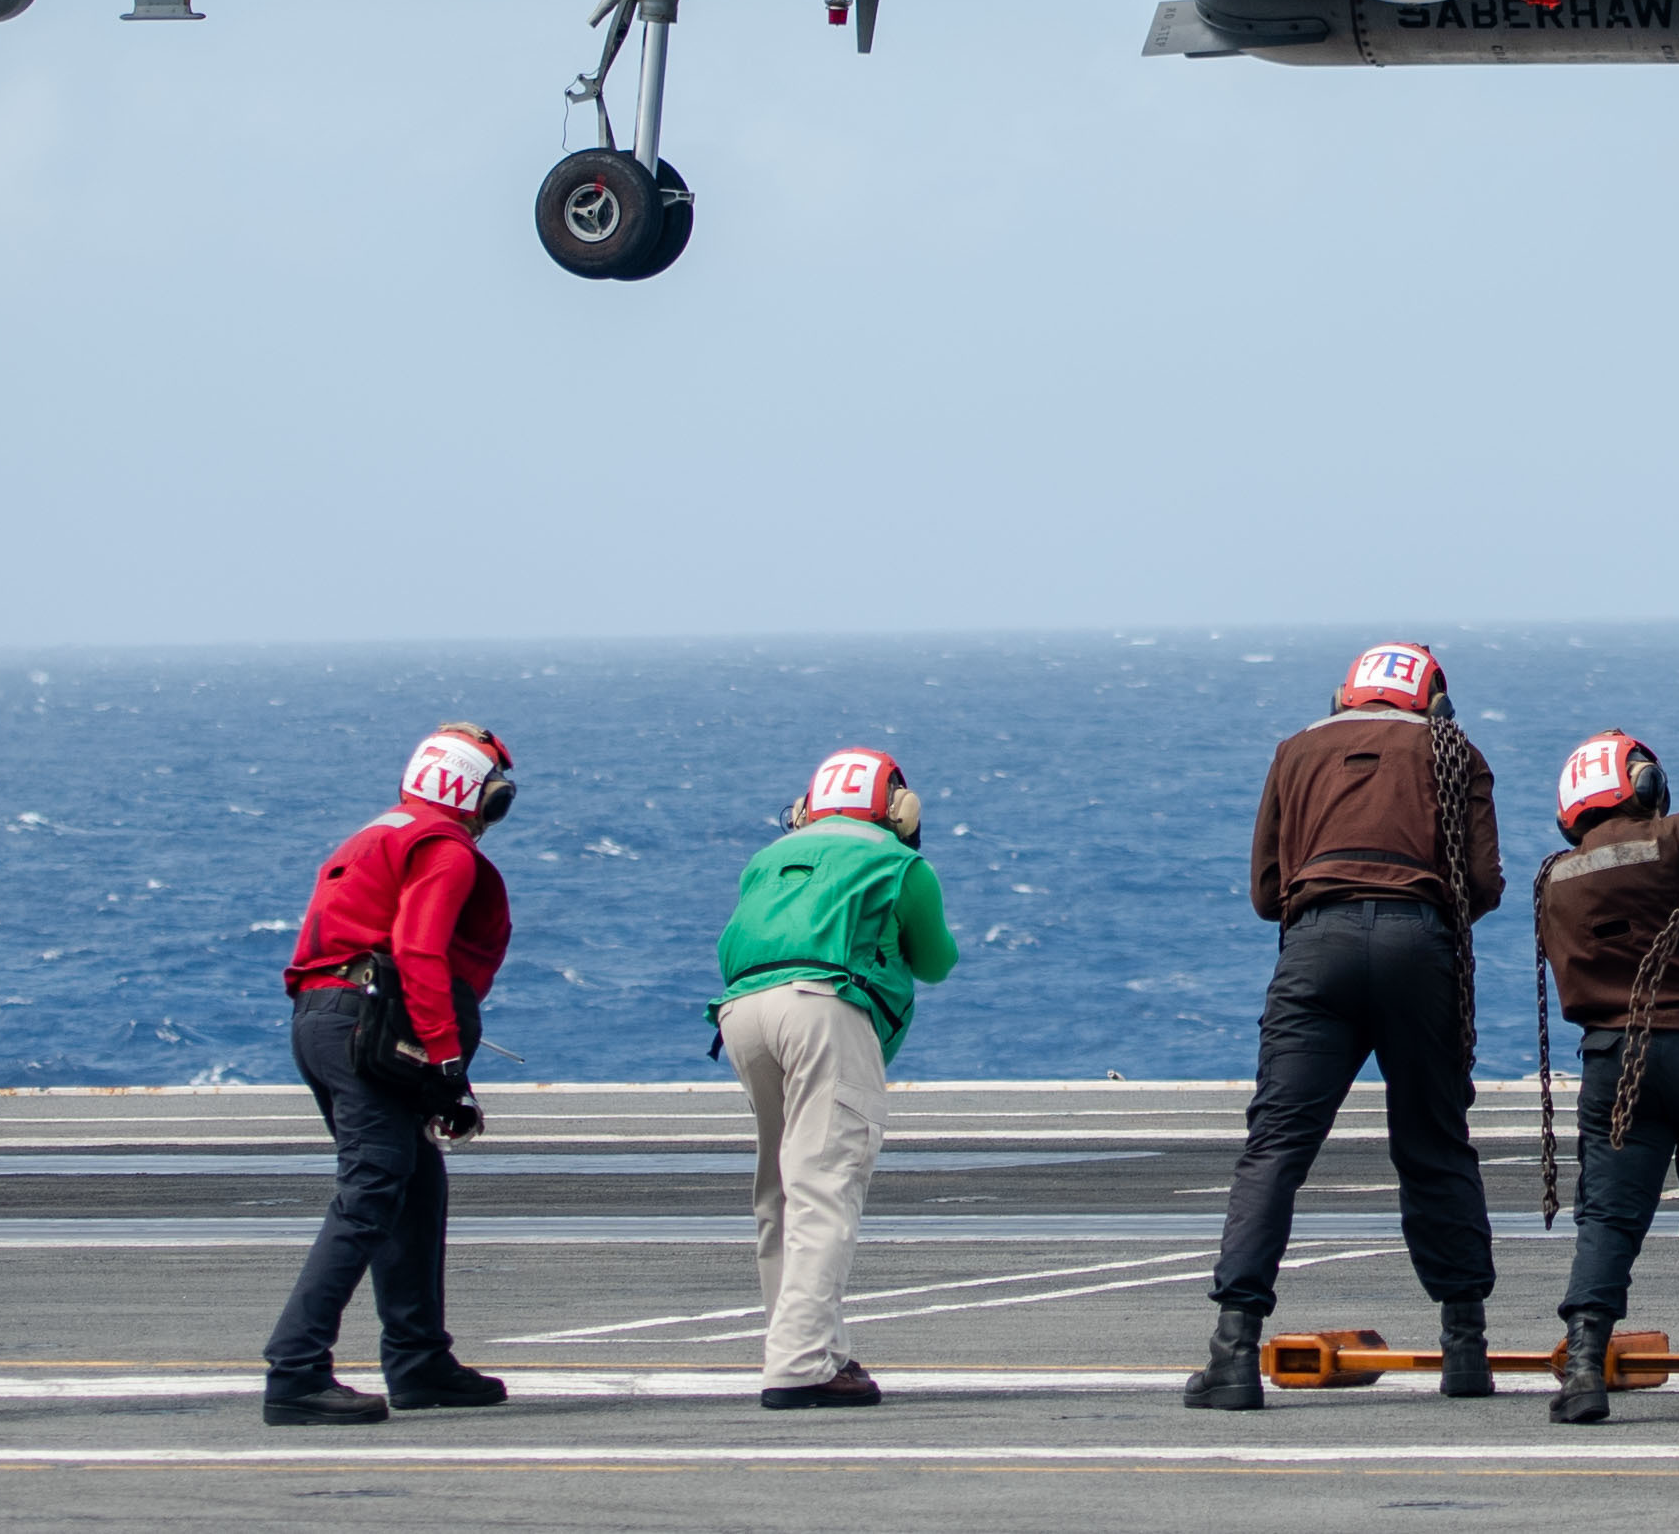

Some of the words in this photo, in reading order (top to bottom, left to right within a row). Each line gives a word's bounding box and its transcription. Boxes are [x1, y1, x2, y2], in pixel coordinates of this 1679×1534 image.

[1362, 652, 1420, 684] 7H
[411, 745, 482, 808] 7W
[822, 763, 867, 796] 7C
[1567, 746, 1610, 790] 7H
